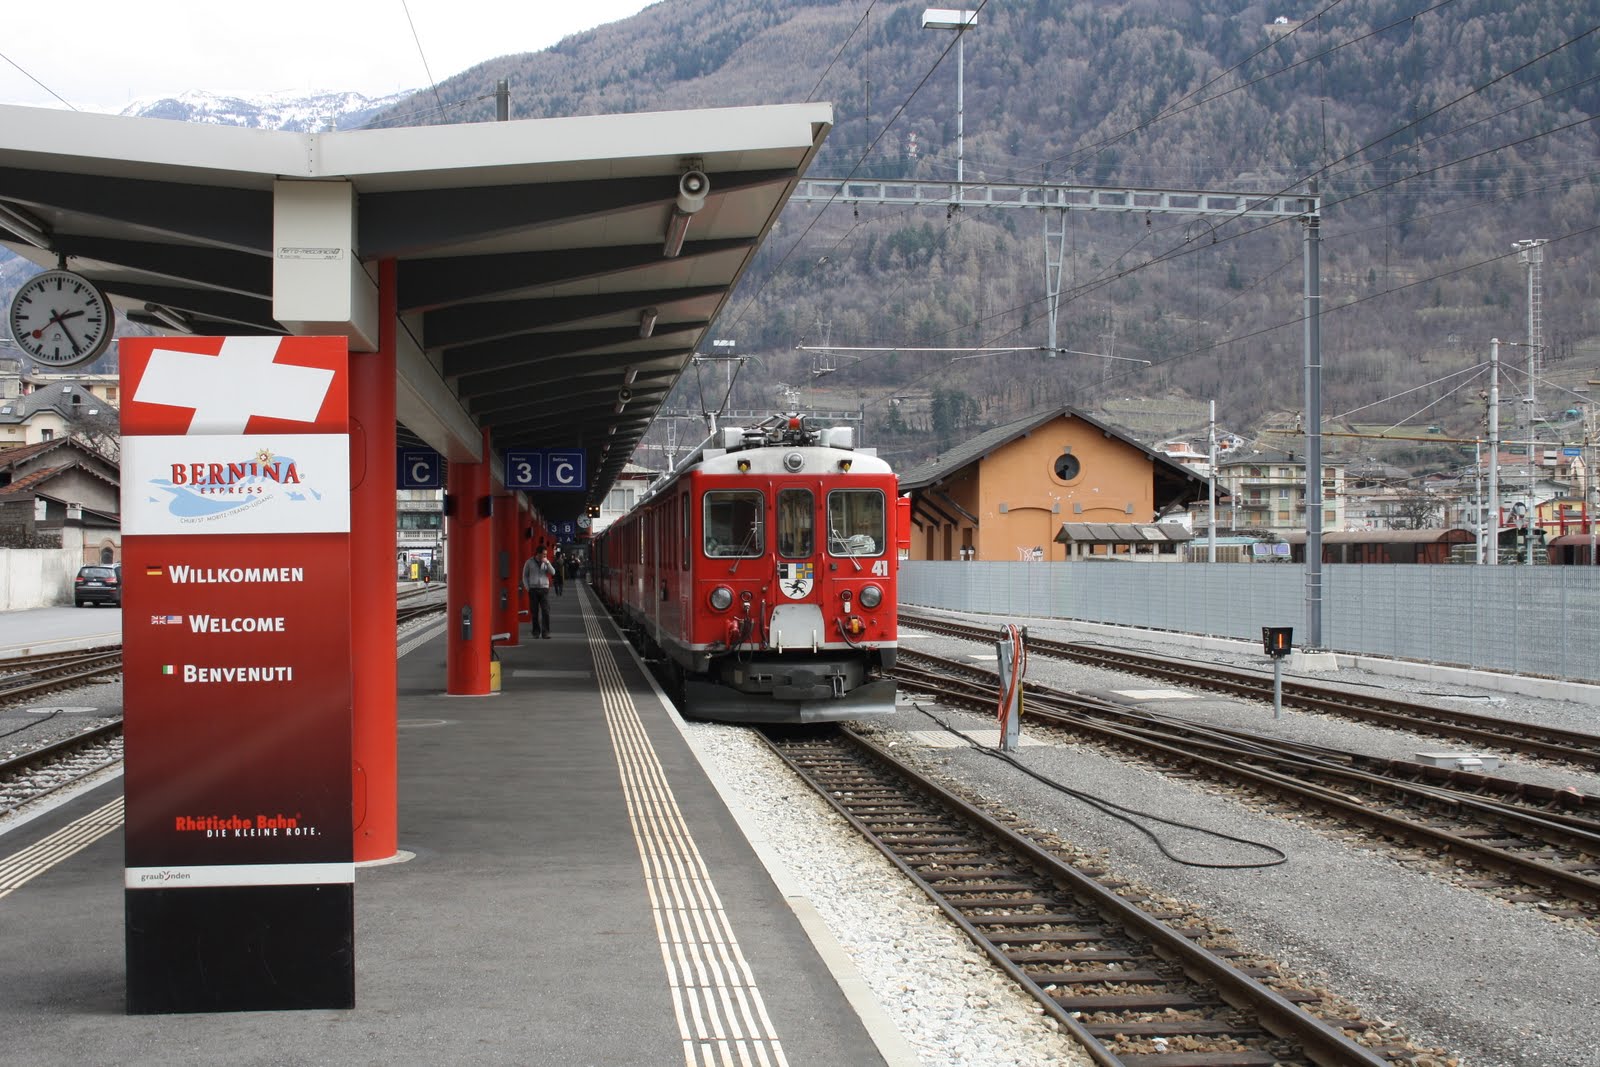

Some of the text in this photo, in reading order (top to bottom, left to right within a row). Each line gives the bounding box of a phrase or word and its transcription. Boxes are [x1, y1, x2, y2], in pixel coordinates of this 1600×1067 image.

[171, 463, 300, 485] BERNINA
[412, 462, 430, 483] C
[516, 462, 533, 483] 3
[555, 462, 574, 484] C
[871, 560, 888, 577] 41
[176, 814, 297, 830] Rhätische Bahn
[206, 827, 322, 838] DIE KLEINE ROTE.
